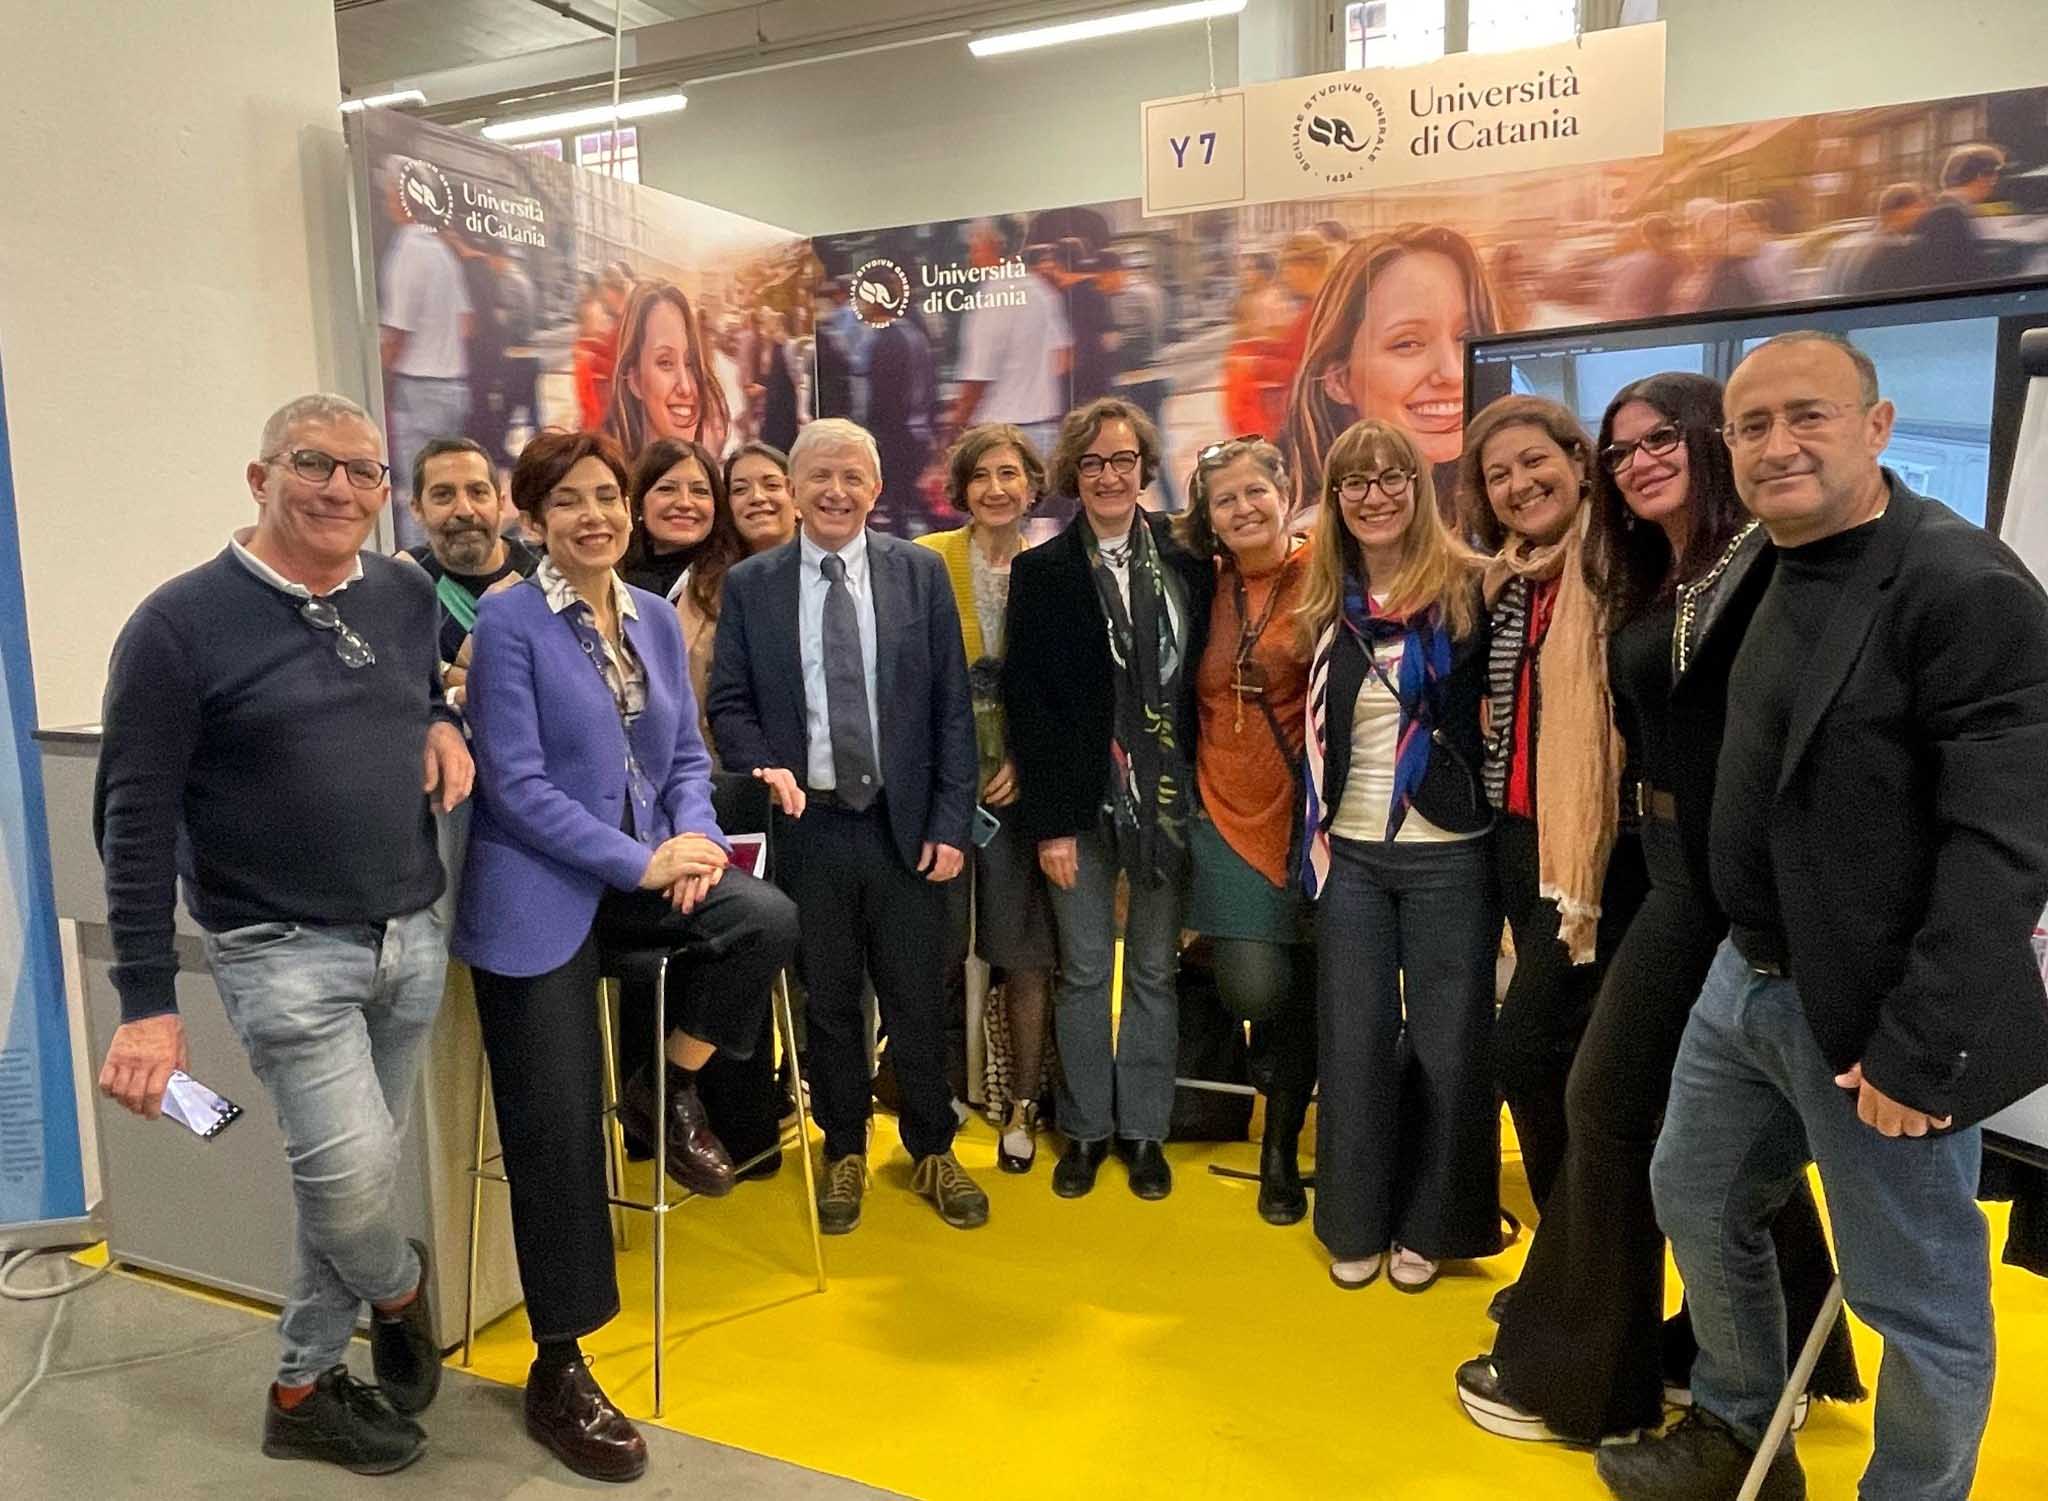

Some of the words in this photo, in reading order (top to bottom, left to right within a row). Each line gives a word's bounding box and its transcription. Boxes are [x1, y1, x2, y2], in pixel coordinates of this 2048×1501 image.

[1410, 65, 1580, 117] Università
[1170, 135, 1191, 168] Y
[1199, 132, 1216, 165] 7
[1410, 124, 1439, 156] di
[1447, 108, 1579, 151] Catania
[463, 182, 545, 222] Università
[466, 211, 482, 234] di
[484, 214, 546, 248] Catania
[921, 255, 1027, 287] Università
[923, 292, 942, 314] di
[945, 285, 1027, 312] Catania
